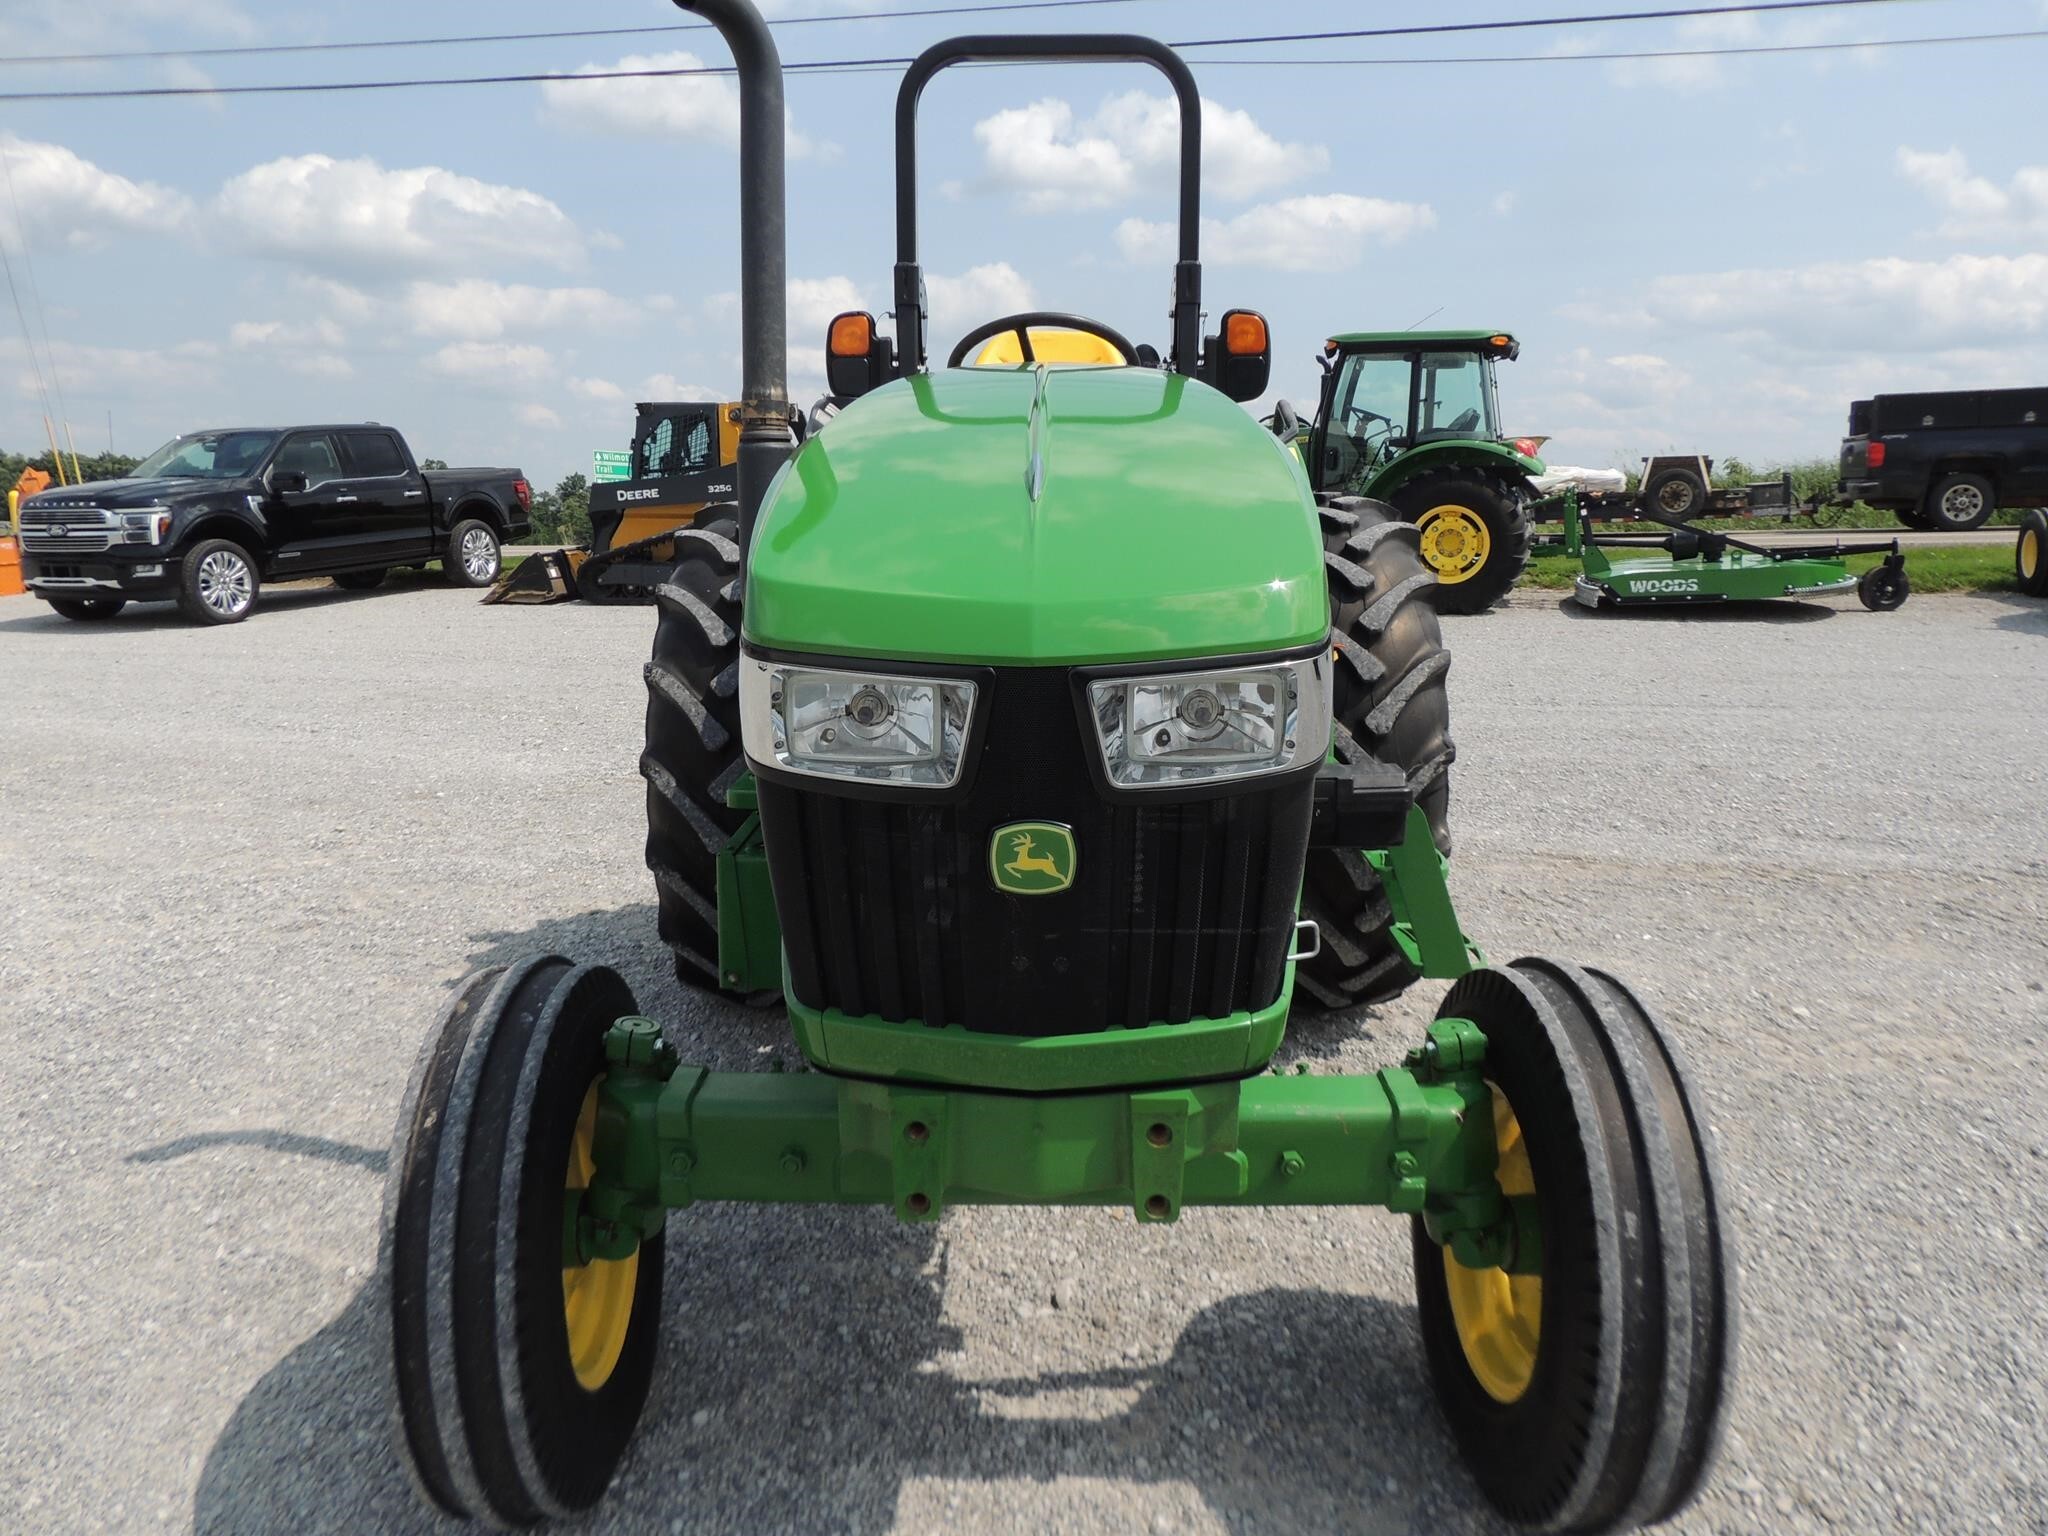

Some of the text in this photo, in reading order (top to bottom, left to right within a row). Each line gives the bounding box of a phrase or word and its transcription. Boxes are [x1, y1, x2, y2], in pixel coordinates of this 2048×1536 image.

[596, 465, 613, 474] Trail
[707, 484, 732, 493] 325G
[616, 488, 660, 501] DEERE
[1629, 578, 1699, 593] WOODS
